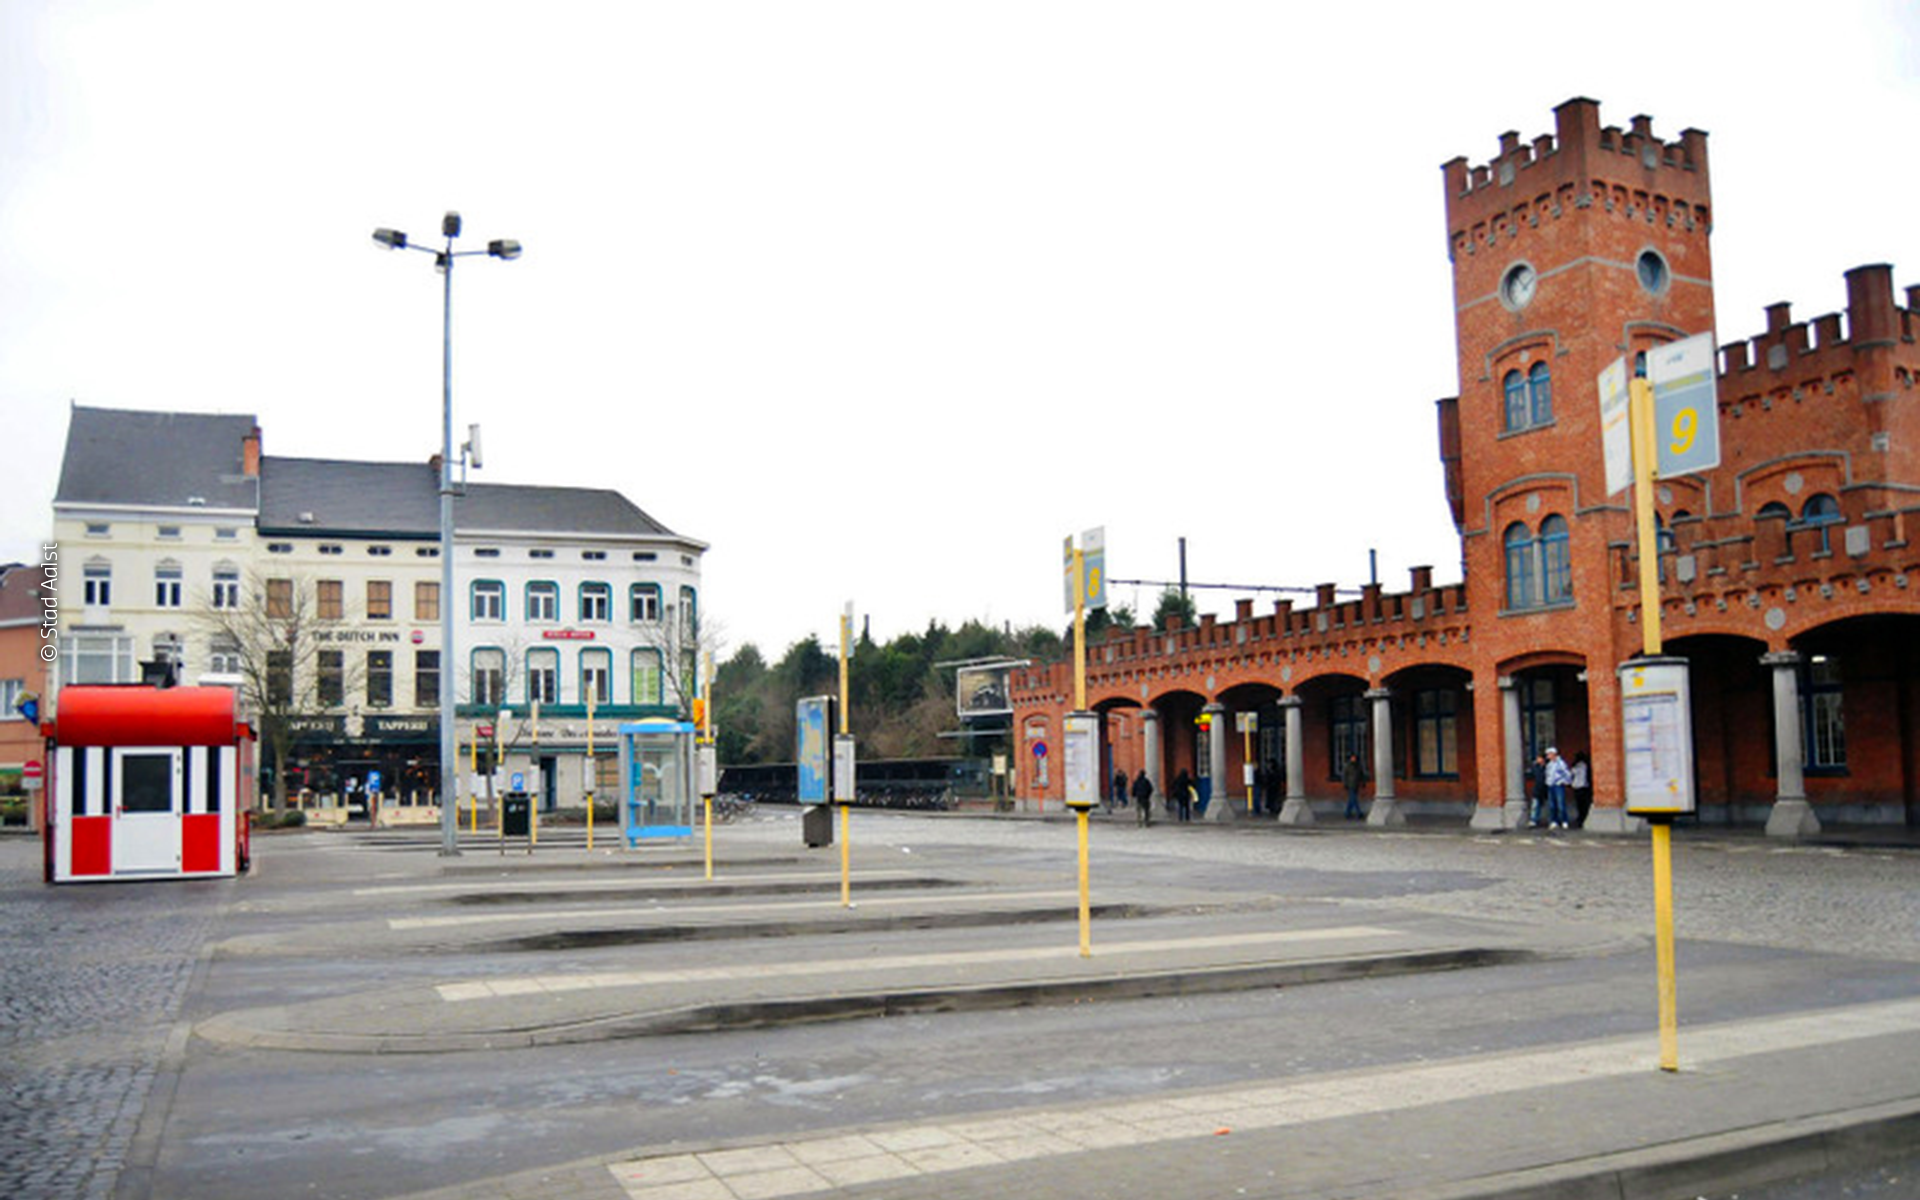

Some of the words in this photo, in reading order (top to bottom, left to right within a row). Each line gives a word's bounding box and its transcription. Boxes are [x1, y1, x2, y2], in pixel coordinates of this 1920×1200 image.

[1670, 407, 1698, 455] 9
[1087, 566, 1101, 599] 8
[312, 630, 333, 642] THE
[337, 630, 376, 642] DUTCH
[379, 630, 400, 642] INN
